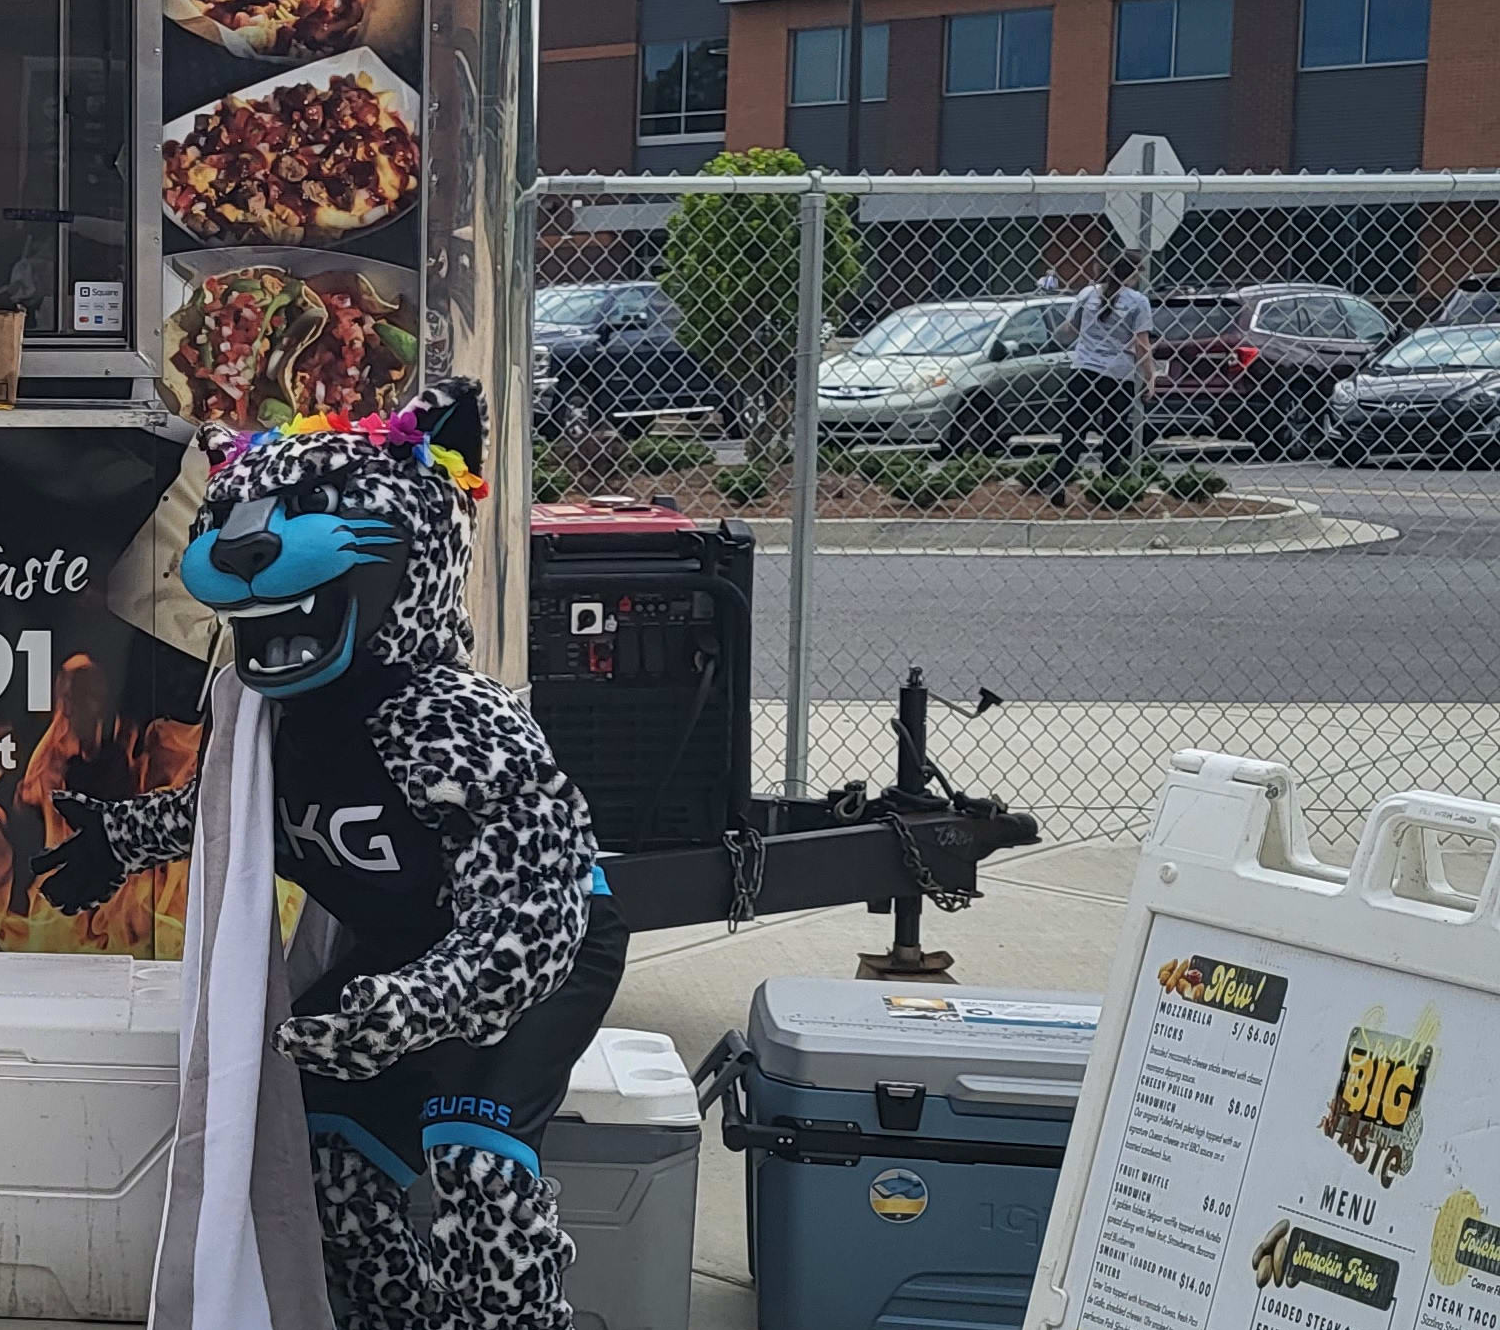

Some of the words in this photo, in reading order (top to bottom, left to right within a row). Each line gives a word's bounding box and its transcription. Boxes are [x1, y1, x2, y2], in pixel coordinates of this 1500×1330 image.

[92, 287, 118, 298] Square
[1204, 965, 1267, 1013] New!
[1153, 1022, 1184, 1042] STICKS
[1159, 1001, 1213, 1027] MOZZARELLA
[1231, 1022, 1244, 1041] 5/
[1247, 1023, 1276, 1046] $6.00
[1140, 1074, 1167, 1091] CHEESY
[1167, 1081, 1193, 1099] PULLED
[1194, 1091, 1214, 1106] PORK
[1227, 1098, 1257, 1120] $8.00
[1342, 1054, 1419, 1126] BIG
[420, 1095, 512, 1127] GUARS
[1114, 1181, 1152, 1203] SANDWICH
[1118, 1163, 1140, 1180] FRUIT
[1141, 1169, 1170, 1190] WAFFLE
[1202, 1195, 1231, 1218] $8.00
[1320, 1185, 1377, 1225] MENU
[1095, 1261, 1121, 1280] TATERS
[1099, 1244, 1129, 1262] SMOKIN'
[1130, 1254, 1157, 1274] LOADED
[1158, 1265, 1177, 1282] PORK
[1179, 1272, 1211, 1297] $14.00
[1293, 1241, 1343, 1279] Smackin
[1344, 1258, 1379, 1291] Fries
[1261, 1295, 1303, 1324] LOADED
[1428, 1293, 1463, 1317] STEAK
[1468, 1306, 1497, 1329] TACO
